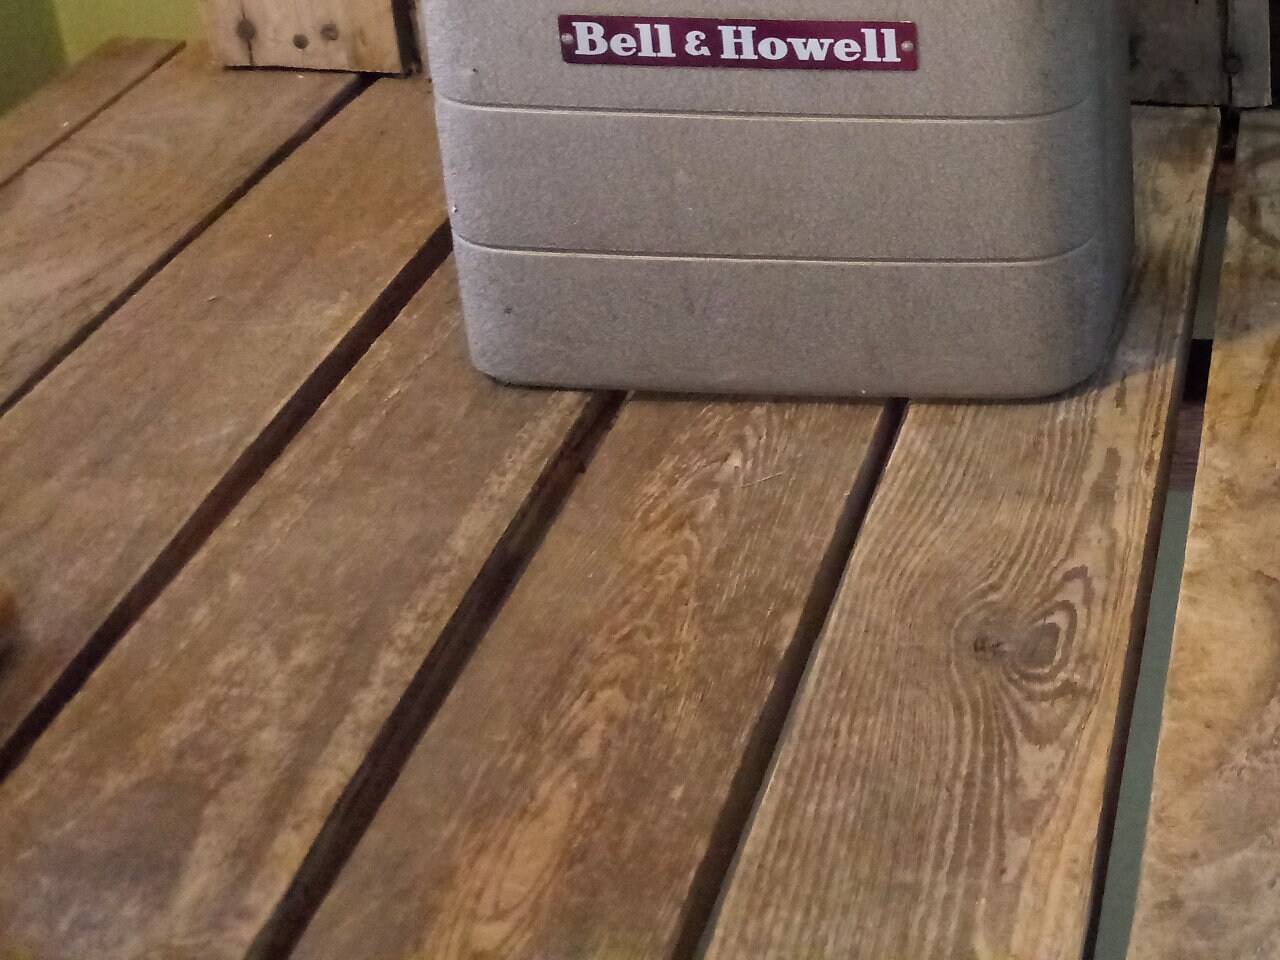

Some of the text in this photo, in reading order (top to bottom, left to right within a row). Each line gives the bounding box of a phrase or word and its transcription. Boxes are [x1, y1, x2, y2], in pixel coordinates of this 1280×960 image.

[572, 21, 901, 63] Bell & Howell
